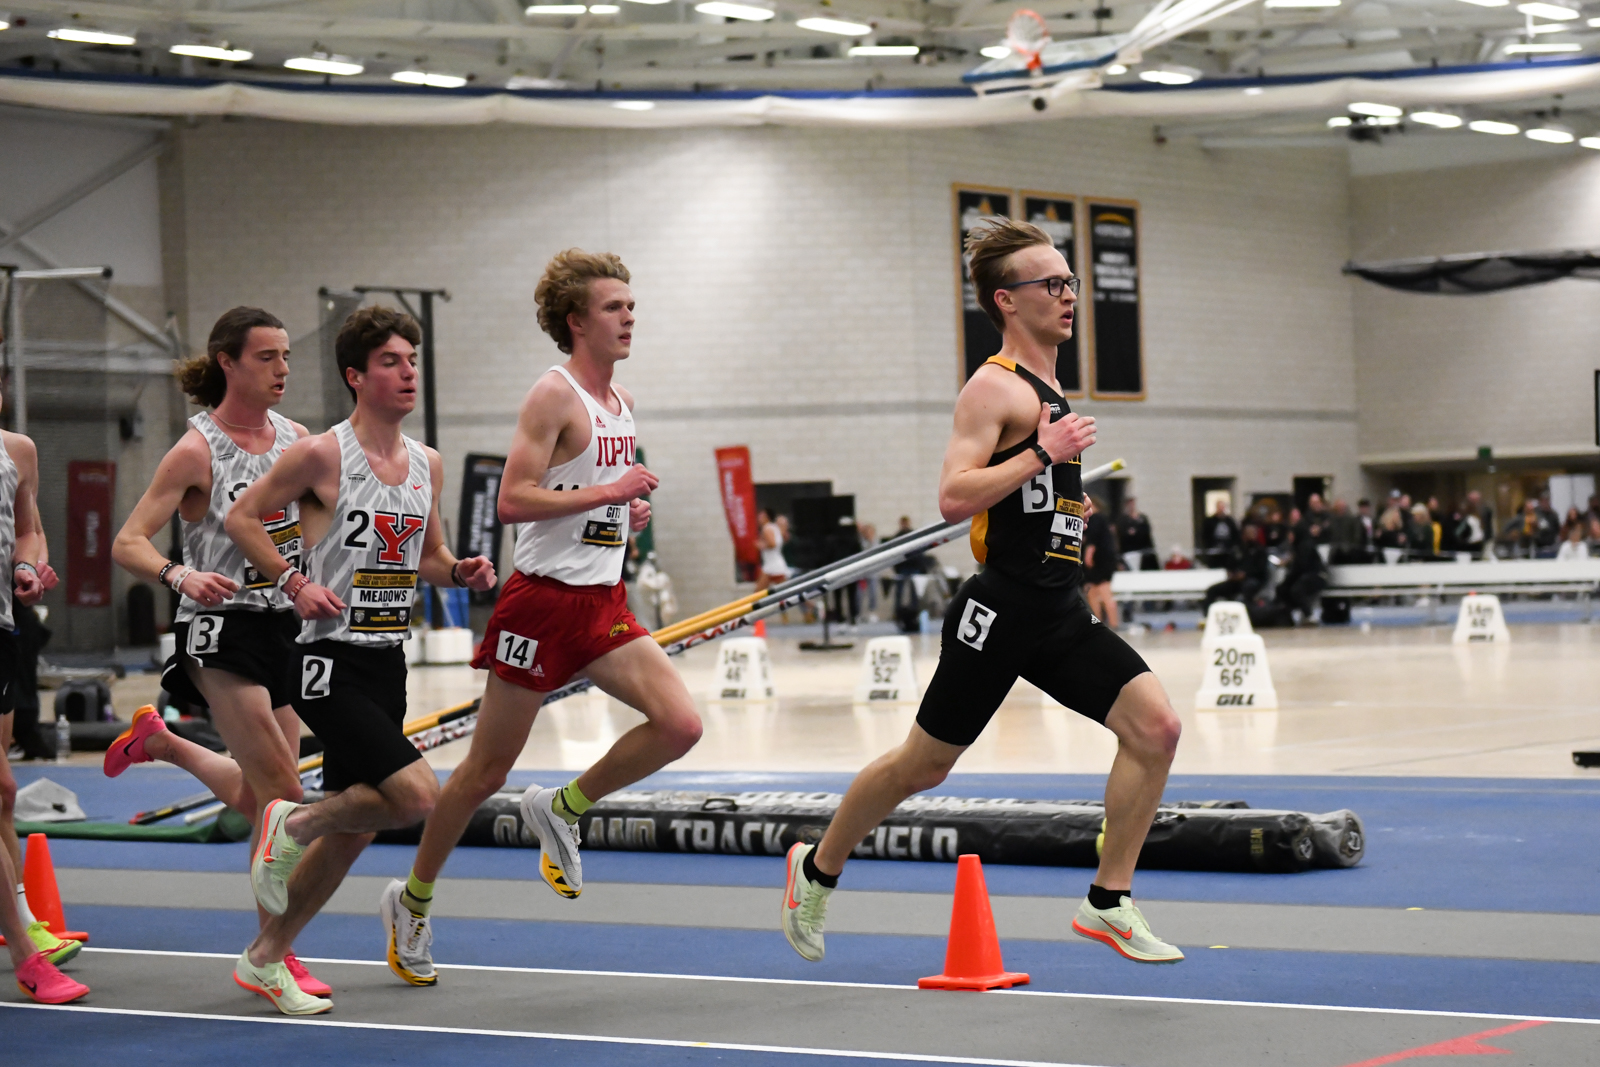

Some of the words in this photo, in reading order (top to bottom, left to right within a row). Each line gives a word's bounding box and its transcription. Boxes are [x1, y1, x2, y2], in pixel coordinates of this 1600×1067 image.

[1030, 466, 1049, 510] 5
[344, 509, 370, 549] 2
[373, 511, 424, 565] Y
[278, 540, 299, 557] RLING
[359, 589, 408, 603] MEADOWS
[194, 616, 215, 652] 3
[962, 604, 990, 644] 5
[504, 635, 530, 667] 14
[1214, 648, 1256, 667] 20m
[304, 658, 326, 697] 2
[1216, 693, 1255, 706] GILL
[669, 818, 789, 853] TRACK
